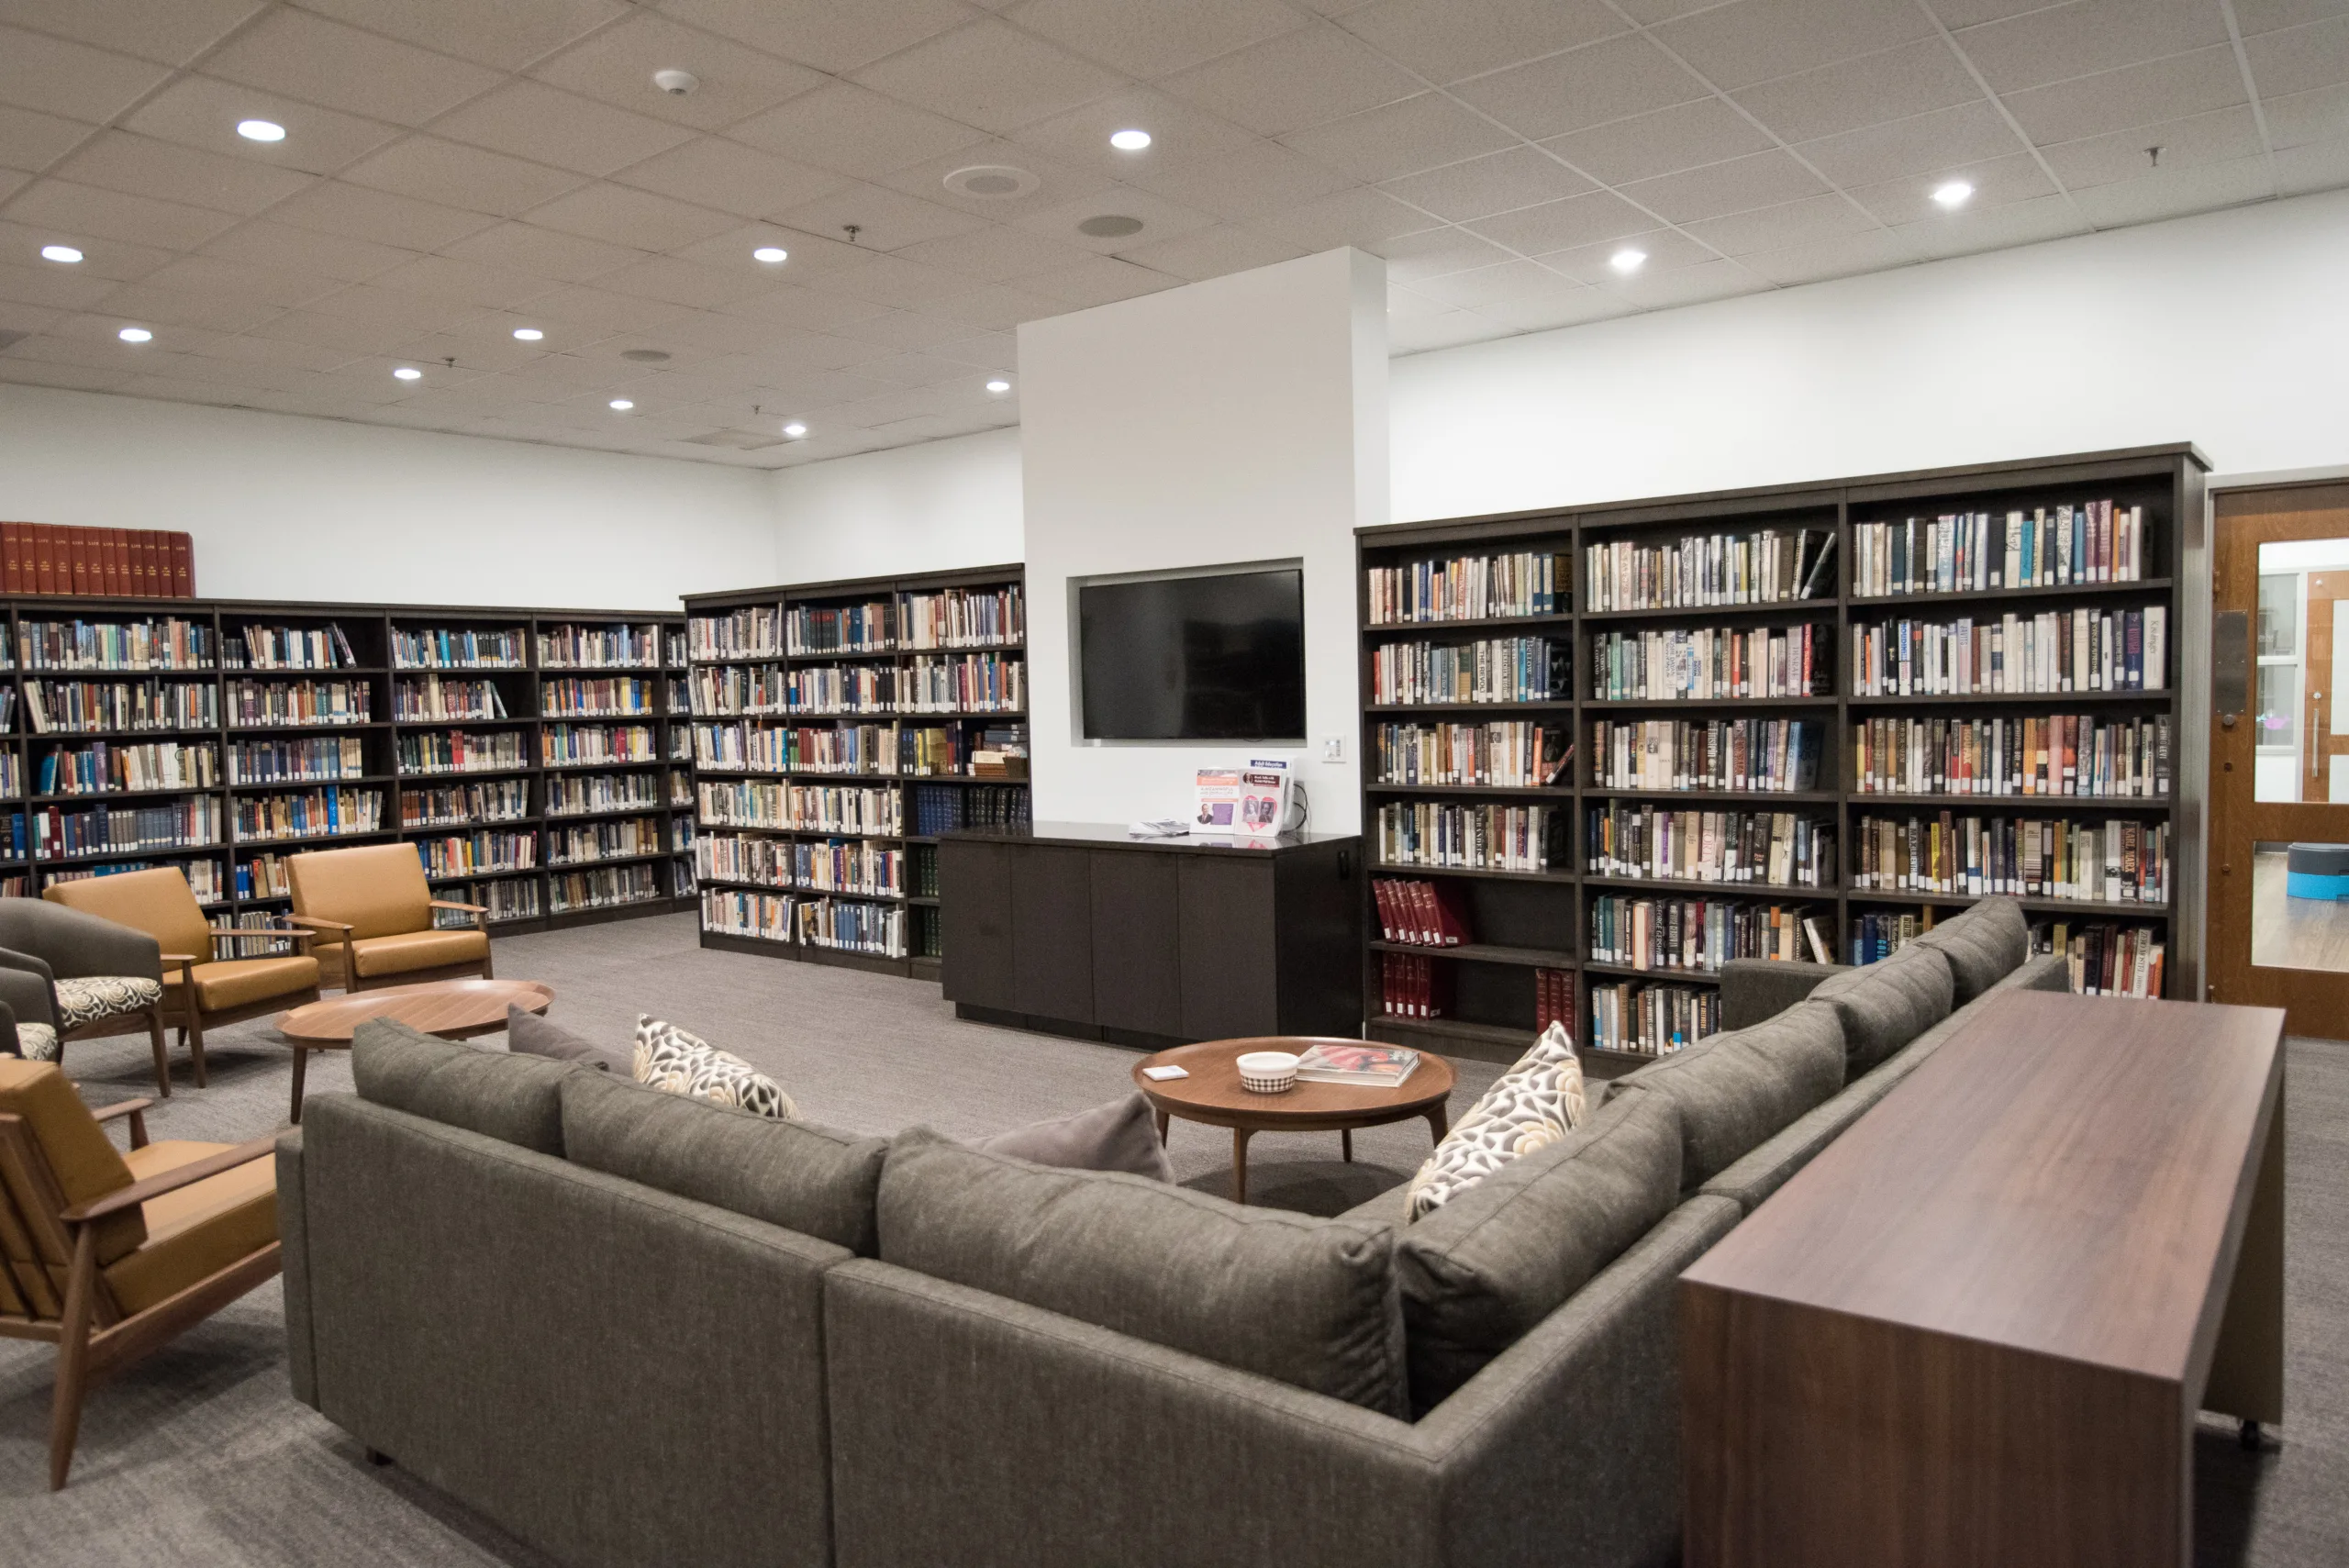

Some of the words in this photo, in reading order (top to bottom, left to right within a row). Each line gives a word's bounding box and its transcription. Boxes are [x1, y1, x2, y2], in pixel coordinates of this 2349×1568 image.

[2147, 620, 2159, 654] Kissinger
[1708, 728, 1717, 757] Einstein
[1964, 729, 1972, 764] KOUFAX
[2159, 745, 2167, 759] LEVI
[2125, 828, 2134, 849] KARL
[2125, 851, 2135, 873] MARX
[2140, 931, 2148, 948] ZERO
